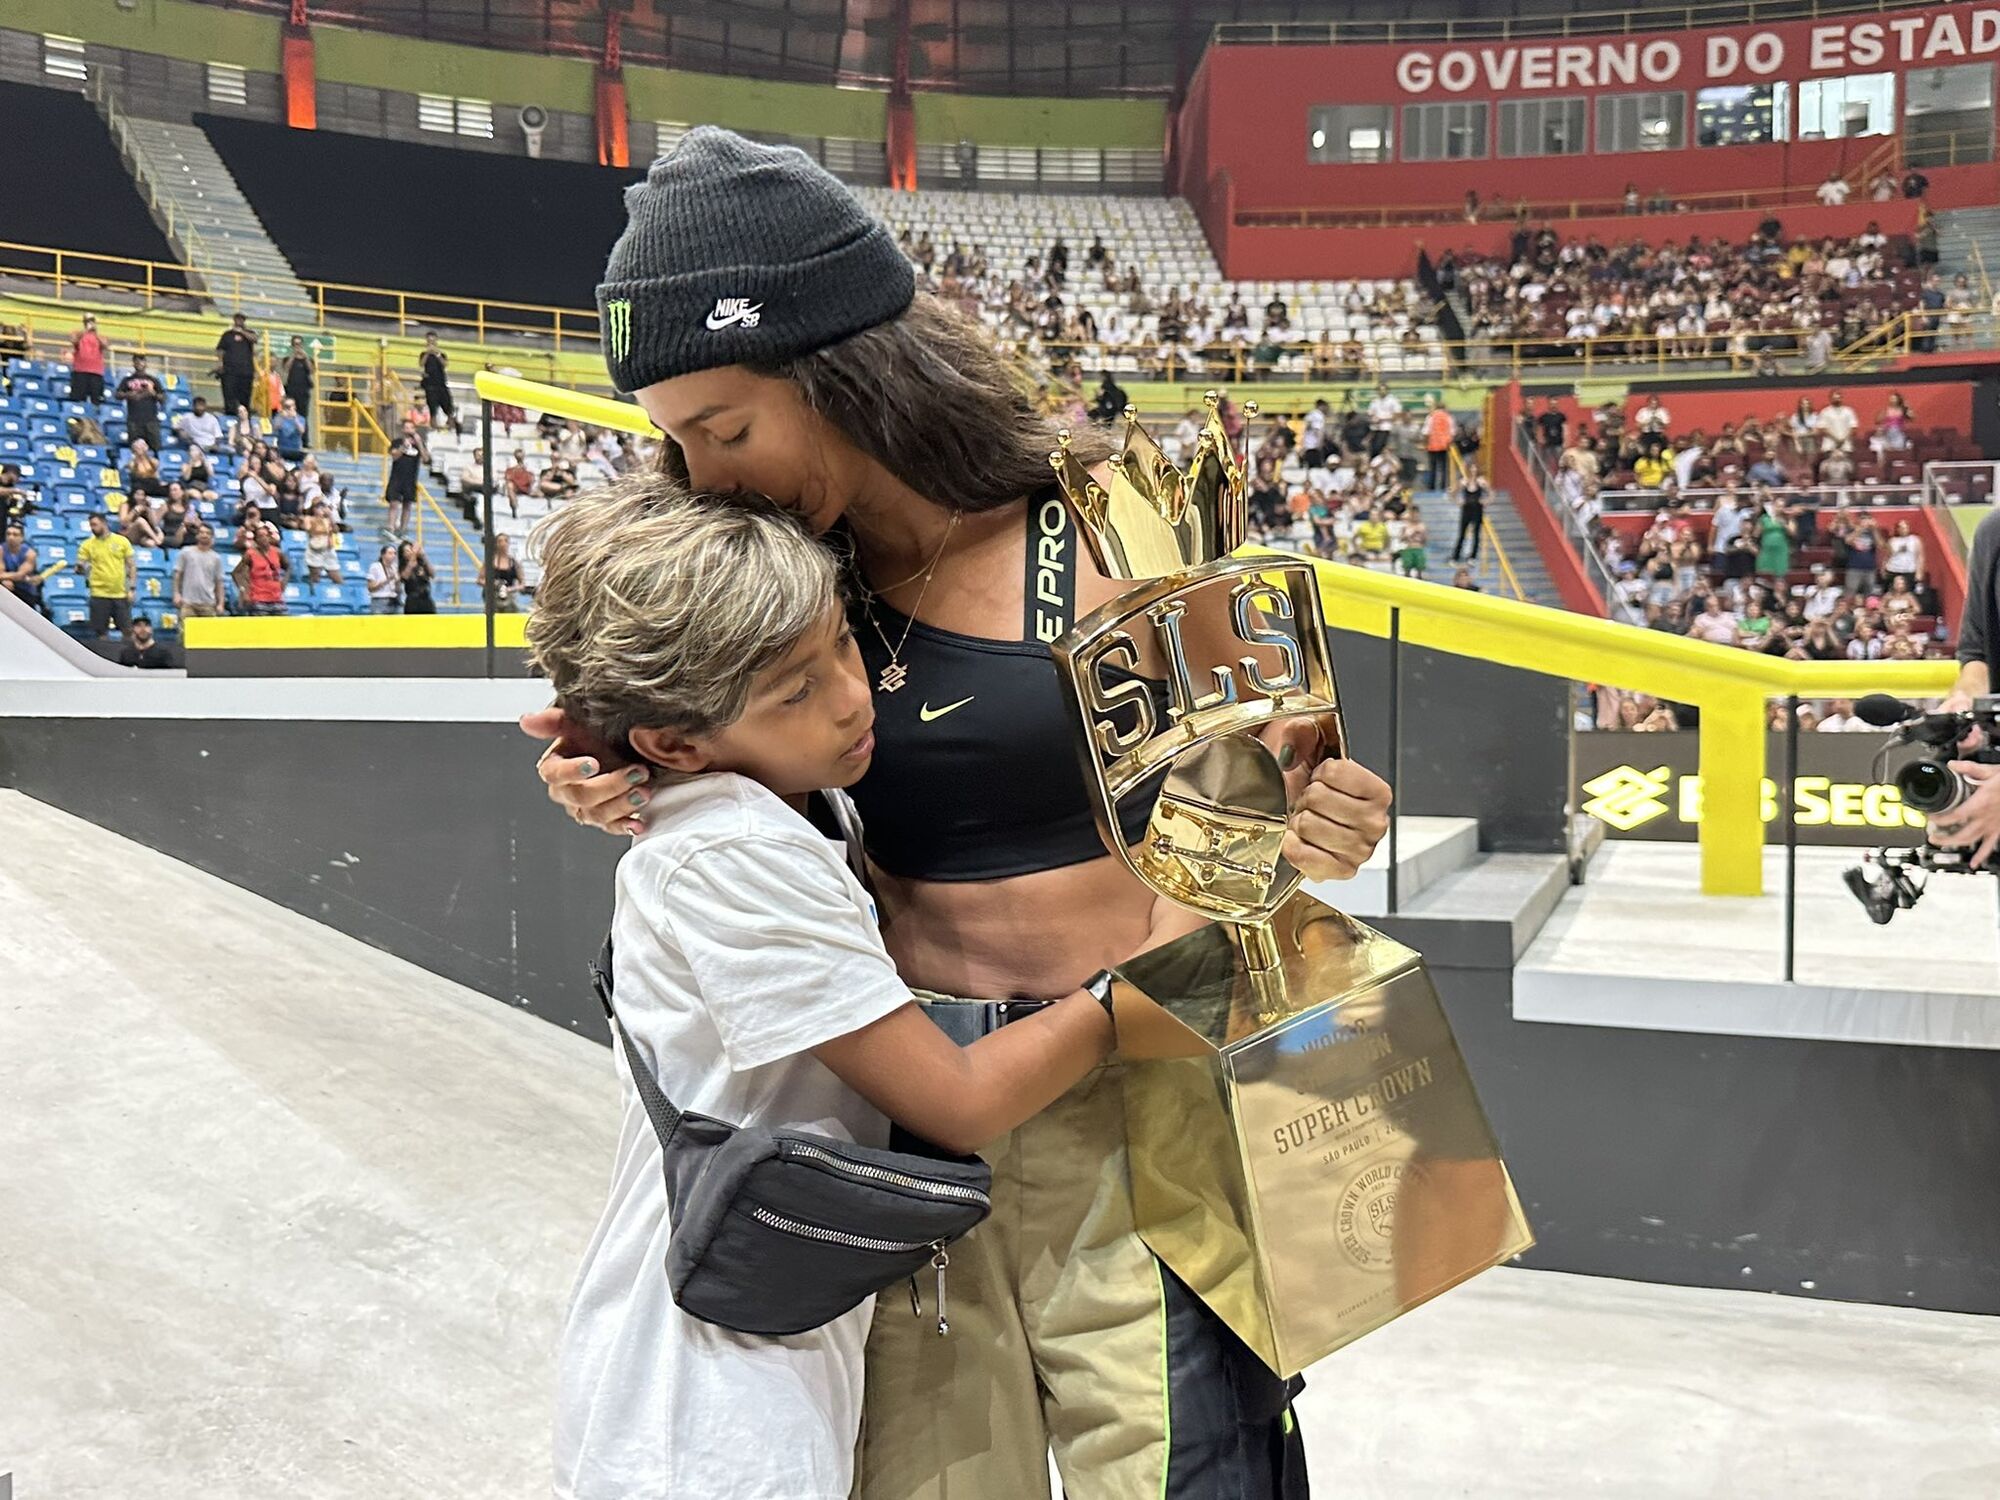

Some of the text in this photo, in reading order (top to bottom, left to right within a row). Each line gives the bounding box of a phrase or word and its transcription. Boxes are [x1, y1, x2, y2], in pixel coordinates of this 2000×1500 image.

[1397, 9, 2000, 93] GOVERNO DO ESTAD
[715, 299, 750, 317] NIKE
[740, 313, 760, 328] SB
[1037, 499, 1067, 608] PRO
[1087, 581, 1305, 757] SLS
[1273, 1098, 1350, 1155] SUPER
[1353, 1057, 1433, 1116] CROWN
[1343, 1135, 1371, 1156] PAULO
[1340, 1190, 1359, 1233] CROWN
[1355, 1165, 1391, 1192] WORLD
